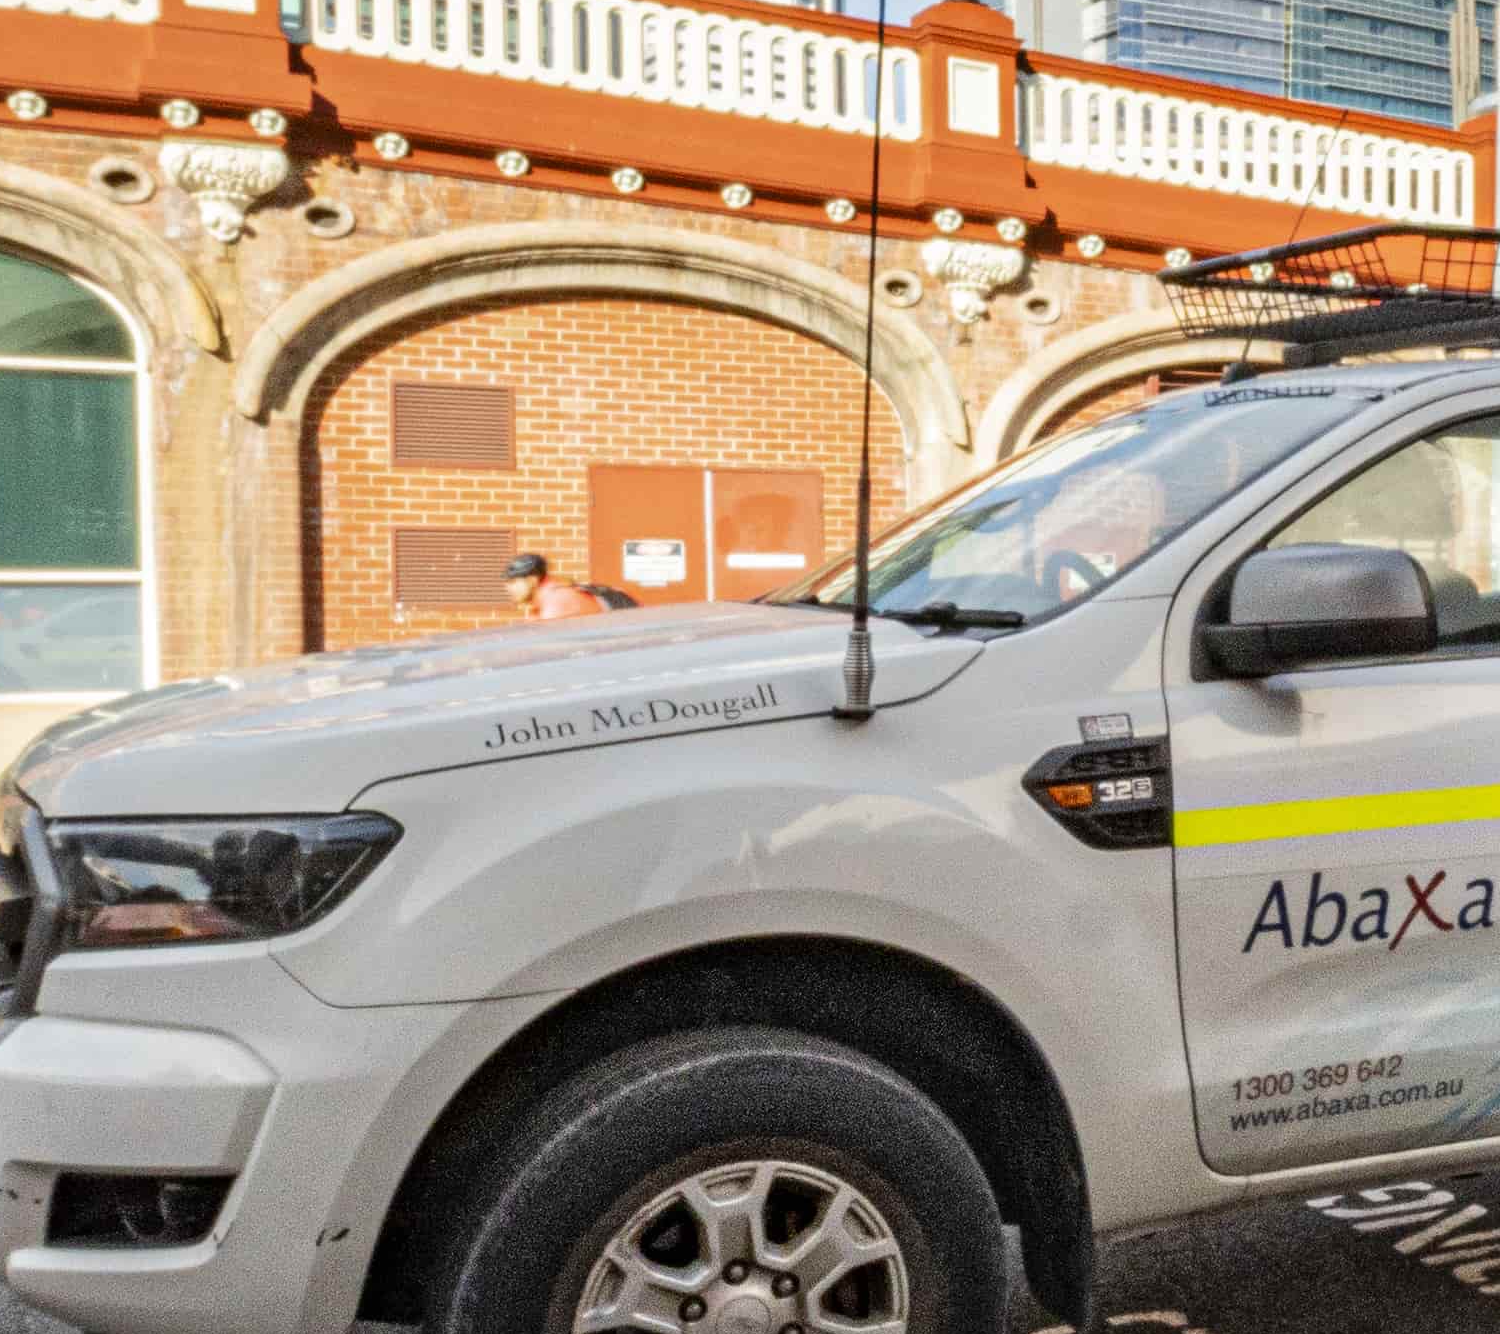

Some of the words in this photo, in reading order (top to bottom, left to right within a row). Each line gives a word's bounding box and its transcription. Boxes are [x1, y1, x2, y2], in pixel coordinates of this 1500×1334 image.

[484, 716, 576, 749] John
[591, 682, 779, 733] McDougall
[1241, 869, 1495, 954] AbaXa
[1229, 1077, 1465, 1132] www.abaxa.com.au
[1232, 1070, 1295, 1102] 1300
[1302, 1062, 1350, 1092] 369
[1356, 1053, 1405, 1083] 642
